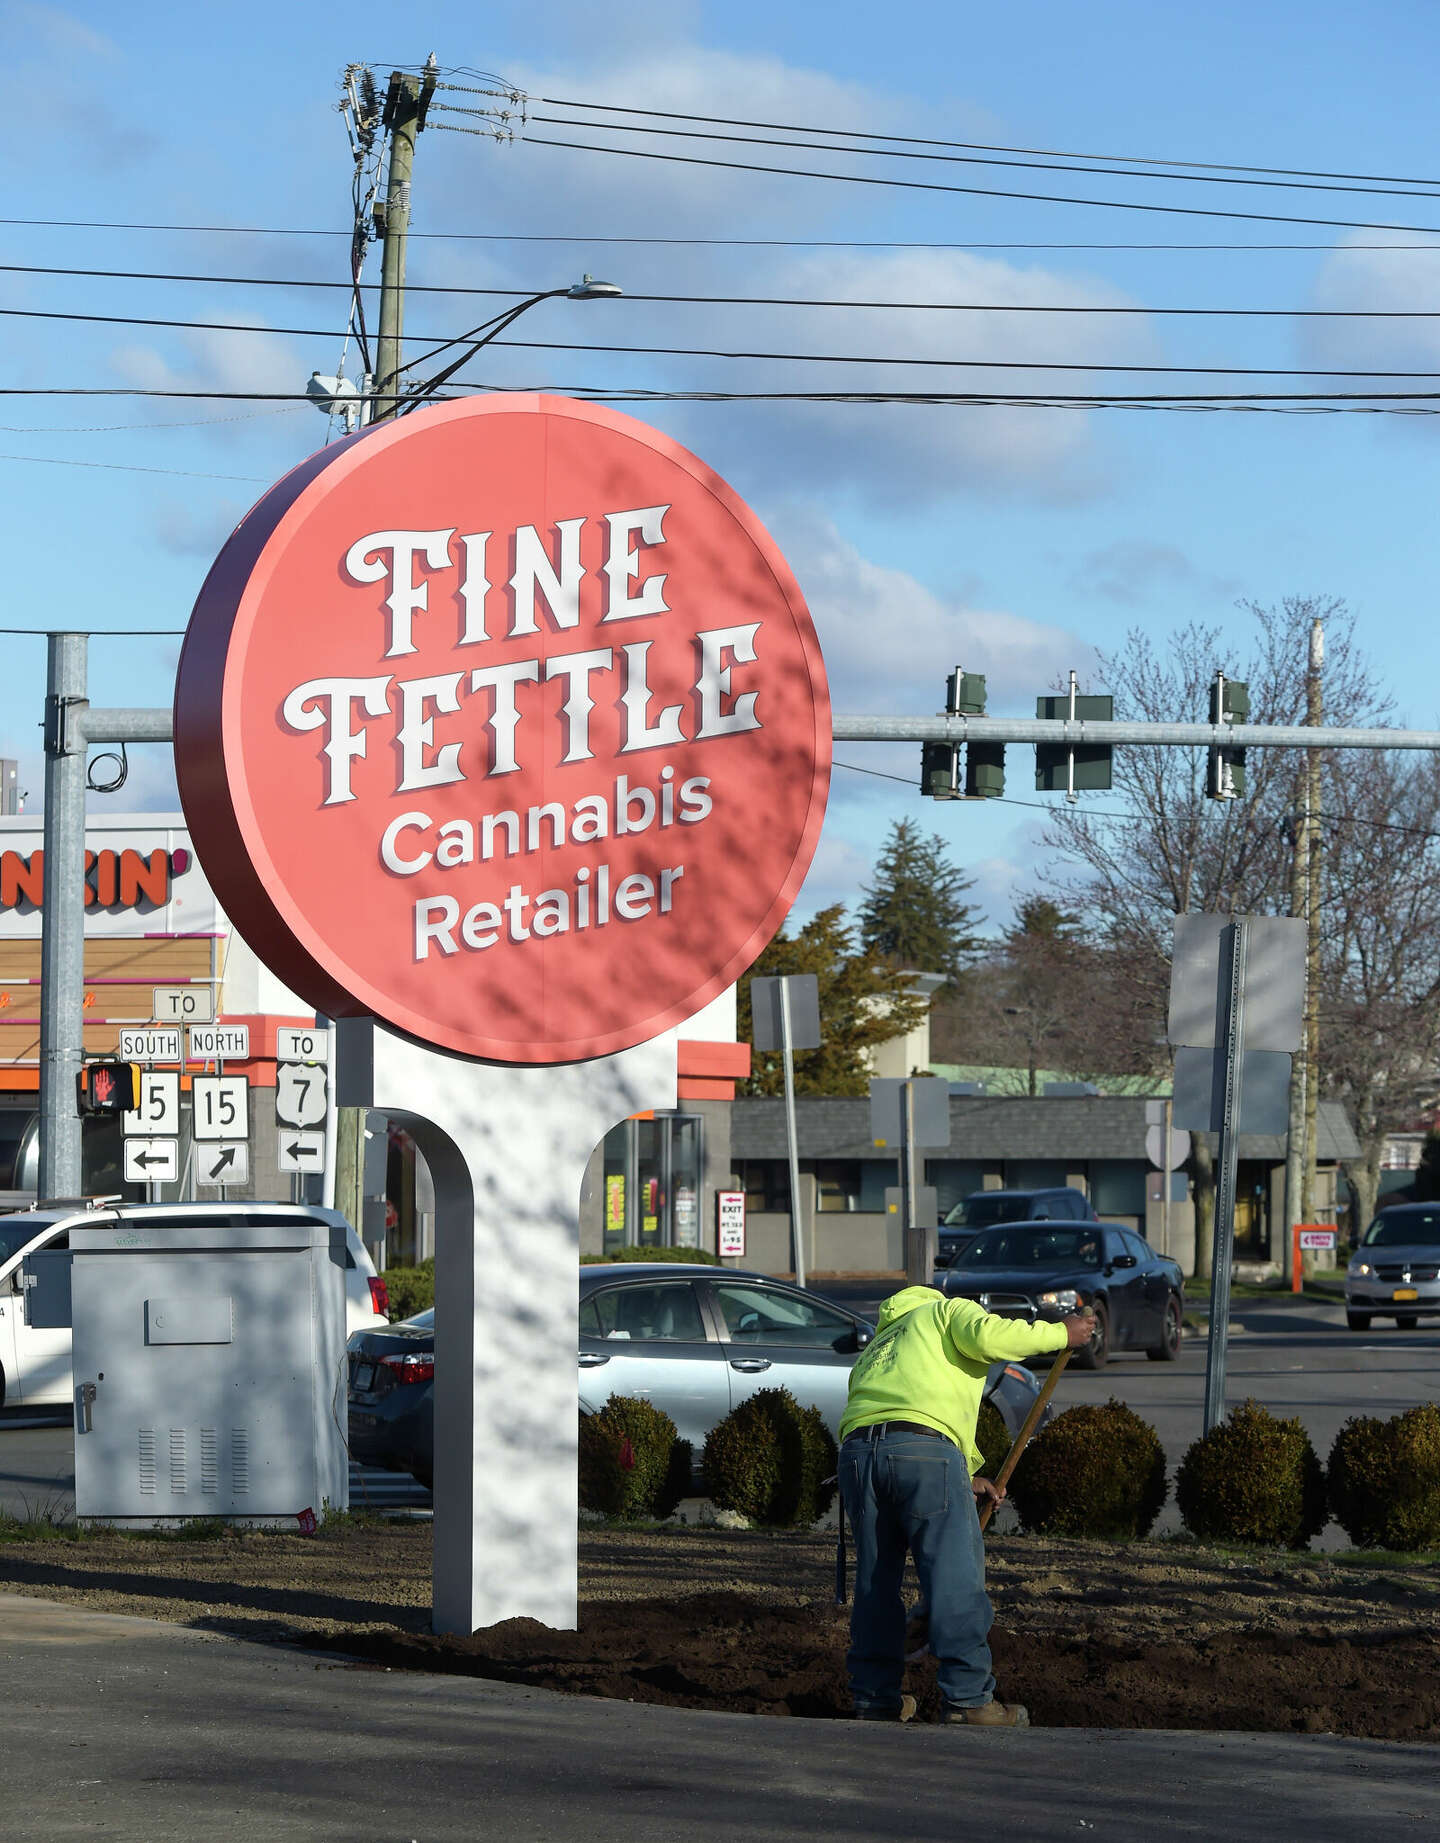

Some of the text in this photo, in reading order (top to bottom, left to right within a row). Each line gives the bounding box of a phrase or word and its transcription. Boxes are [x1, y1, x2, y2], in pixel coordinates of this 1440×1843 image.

[345, 504, 672, 658] FINE
[282, 622, 764, 806] FETTLE
[380, 765, 713, 876] Cannabis
[1, 849, 188, 907] NIN'
[414, 864, 684, 961] Retailer
[169, 994, 196, 1014] TO
[124, 1035, 177, 1055] SOUTH
[194, 1033, 244, 1052] NORTH
[291, 1036, 314, 1055] TO
[205, 1090, 236, 1126] 15
[293, 1079, 311, 1114] 7
[722, 1205, 742, 1213] EXIT
